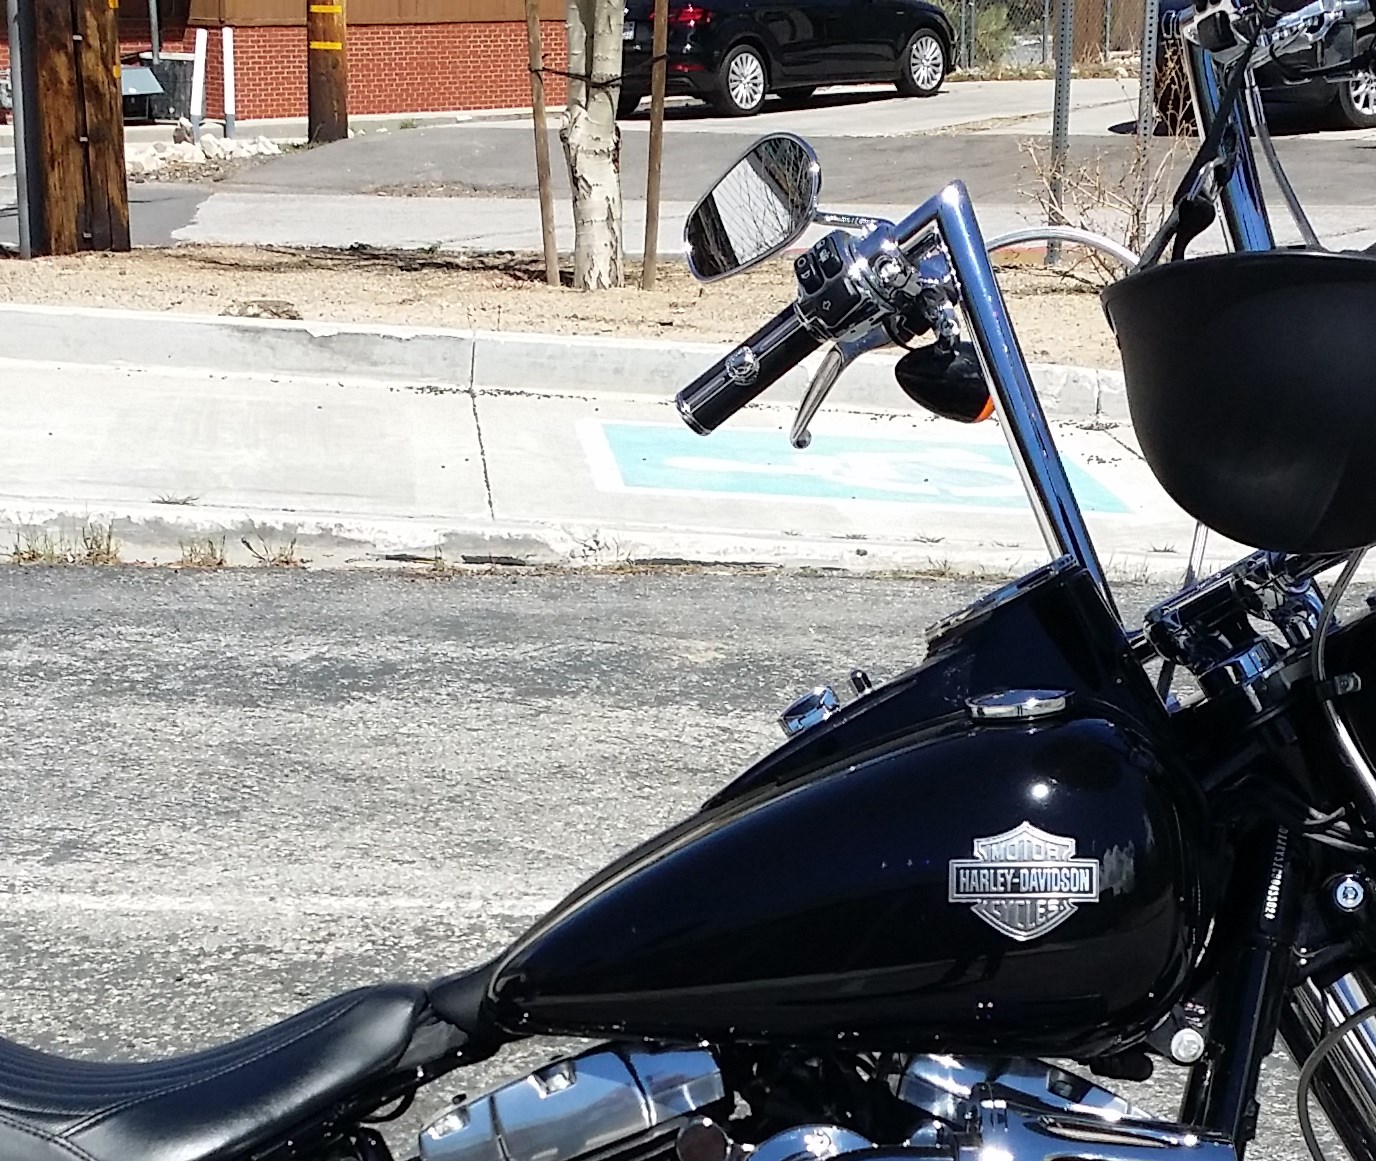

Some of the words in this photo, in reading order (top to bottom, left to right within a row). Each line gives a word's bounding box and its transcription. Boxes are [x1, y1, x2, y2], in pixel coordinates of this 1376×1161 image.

[991, 840, 1063, 861] MOTOR
[959, 868, 1090, 893] HARLEY-DAVIDSON
[992, 900, 1058, 928] CYCLES
